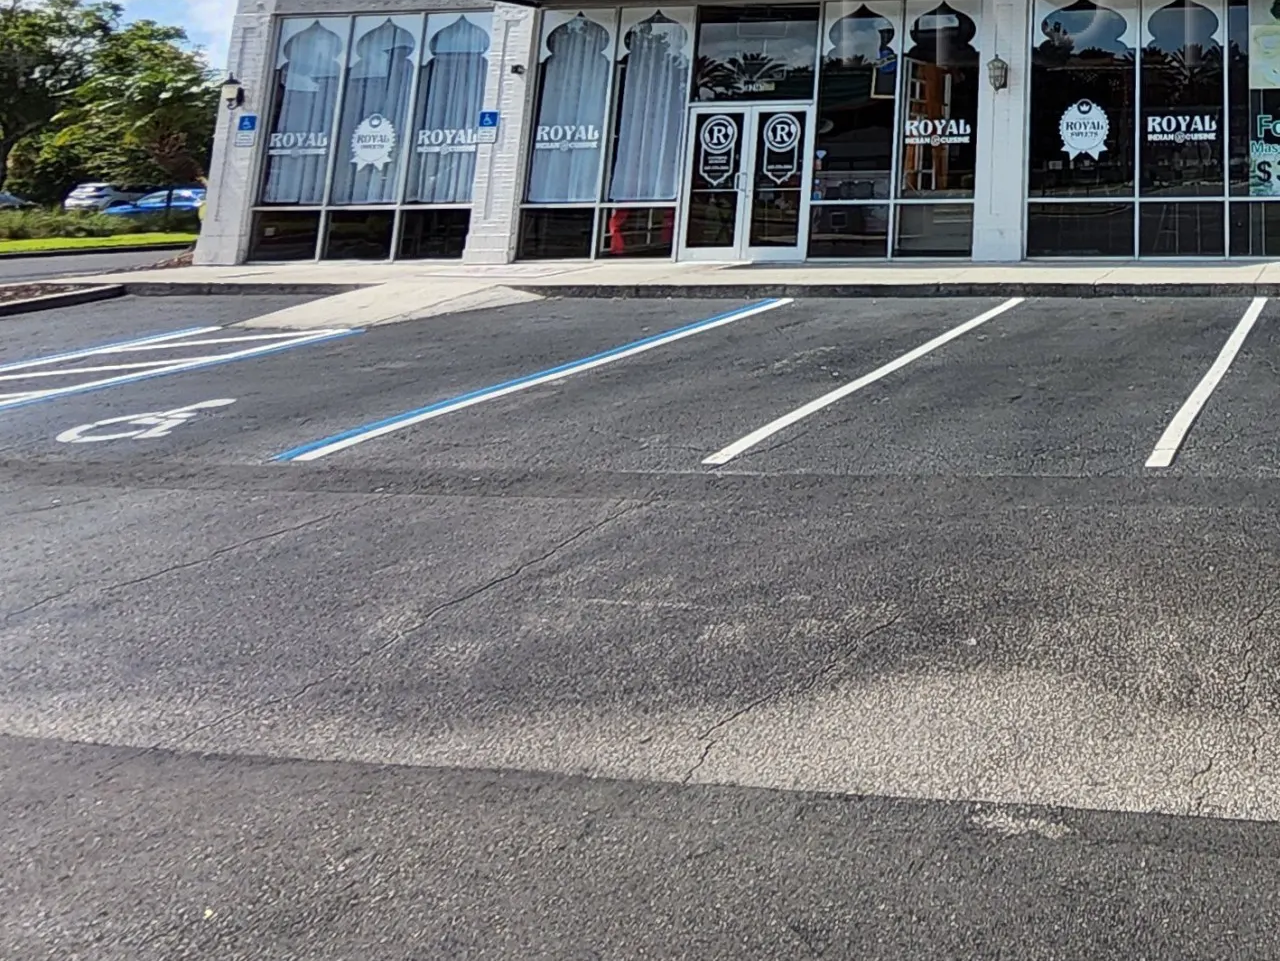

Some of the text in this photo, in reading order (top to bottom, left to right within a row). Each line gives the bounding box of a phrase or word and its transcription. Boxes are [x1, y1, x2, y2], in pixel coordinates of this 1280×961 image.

[905, 119, 971, 136] ROYAL
[1065, 121, 1104, 131] ROYAL
[1147, 115, 1217, 132] ROYAL
[270, 132, 327, 147] ROYAL
[417, 128, 477, 145] ROYAL
[536, 125, 599, 141] ROYAL
